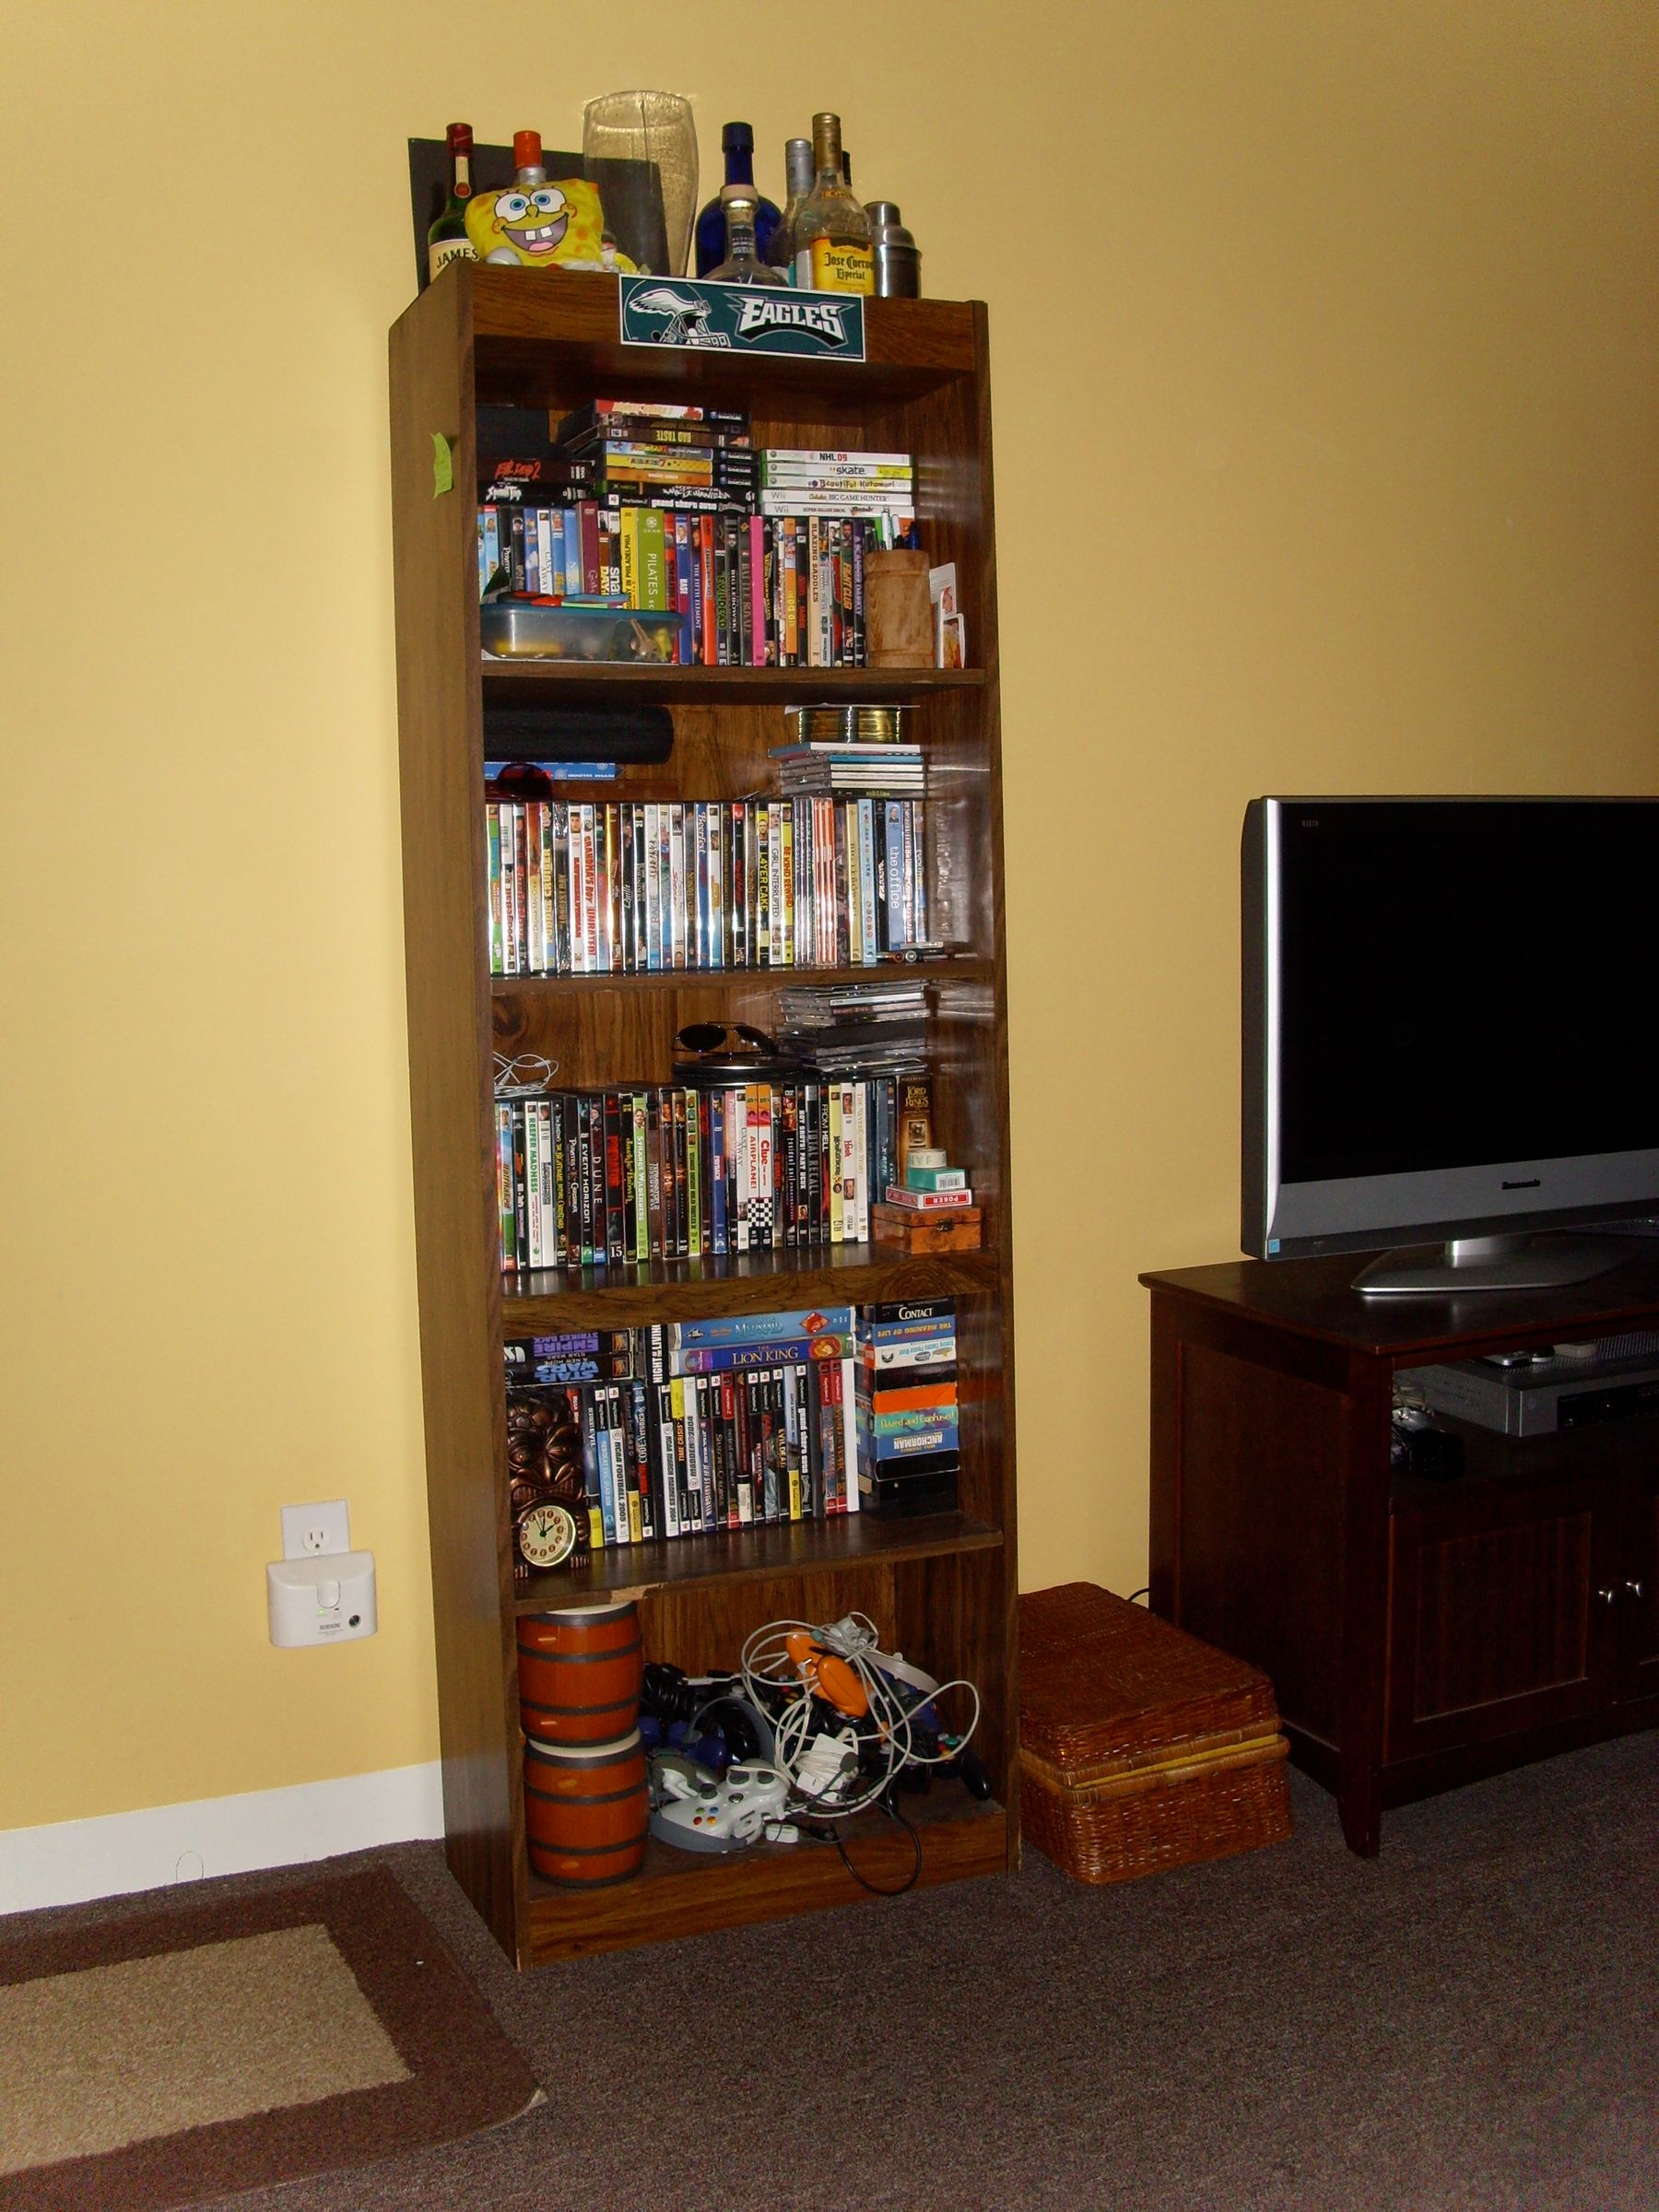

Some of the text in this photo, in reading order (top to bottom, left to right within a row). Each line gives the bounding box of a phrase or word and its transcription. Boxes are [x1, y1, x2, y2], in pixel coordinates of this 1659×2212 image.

[824, 252, 845, 270] Jose
[836, 268, 865, 280] Especial
[738, 297, 842, 341] EAGLES
[656, 429, 677, 442] TASTE
[819, 453, 848, 462] NHL 09
[836, 465, 865, 475] skate
[771, 490, 785, 500] Wii
[819, 479, 857, 488] Beautiful
[774, 505, 789, 513] Wii
[860, 494, 887, 502] HUNTER
[624, 533, 632, 578] PHILADELPHIA
[647, 553, 658, 595] PILATES
[679, 578, 688, 594] BASE
[843, 562, 853, 611] FIGHT CLUB
[717, 575, 726, 629] EVIL DEAD
[741, 562, 752, 636] BATTLE ROYALE
[698, 811, 707, 854] Beerfest
[583, 836, 595, 903] GRANDMA'S BOY
[783, 845, 793, 908] BE KIND REWIND
[889, 846, 901, 909] the office
[543, 848, 553, 944] PUDDLE CRUISER
[623, 884, 632, 910] Quills
[759, 885, 768, 912] CAKE
[771, 868, 780, 917] INTERRUPTED
[587, 908, 596, 956] UNRATED
[650, 894, 659, 948] RAT RACE
[528, 1117, 536, 1149] REEFER
[749, 1135, 758, 1189] AIRPLANE!
[760, 1139, 771, 1165] Clue
[843, 1140, 853, 1158] Hook
[529, 1150, 538, 1194] MADNESS
[623, 1137, 634, 1203] Jackie Brown
[807, 1129, 818, 1196] TOTAL RECALL
[592, 1156, 602, 1205] DUNE
[664, 1162, 672, 1197] MUMMY
[582, 1178, 591, 1224] HORIZON
[933, 1195, 959, 1204] POKER
[610, 1246, 623, 1258] 15
[899, 1306, 934, 1321] CONTACT
[938, 1322, 952, 1330] THE
[877, 1330, 891, 1338] LIFE
[904, 1324, 937, 1335] MEANING
[534, 1339, 600, 1354] EMPIRE
[732, 1346, 799, 1366] LION KING
[535, 1370, 595, 1382] STAR
[536, 1360, 600, 1372] WARS
[653, 1359, 664, 1383] NIGHT
[588, 1428, 596, 1447] EVIL
[777, 1428, 787, 1468] EVIL DEAD
[893, 1431, 944, 1450] ANCHORMAN
[614, 1441, 622, 1463] NCAA
[688, 1443, 697, 1477] MADDEN
[616, 1464, 625, 1500] FOOTBALL
[667, 1476, 676, 1506] MADNESS
